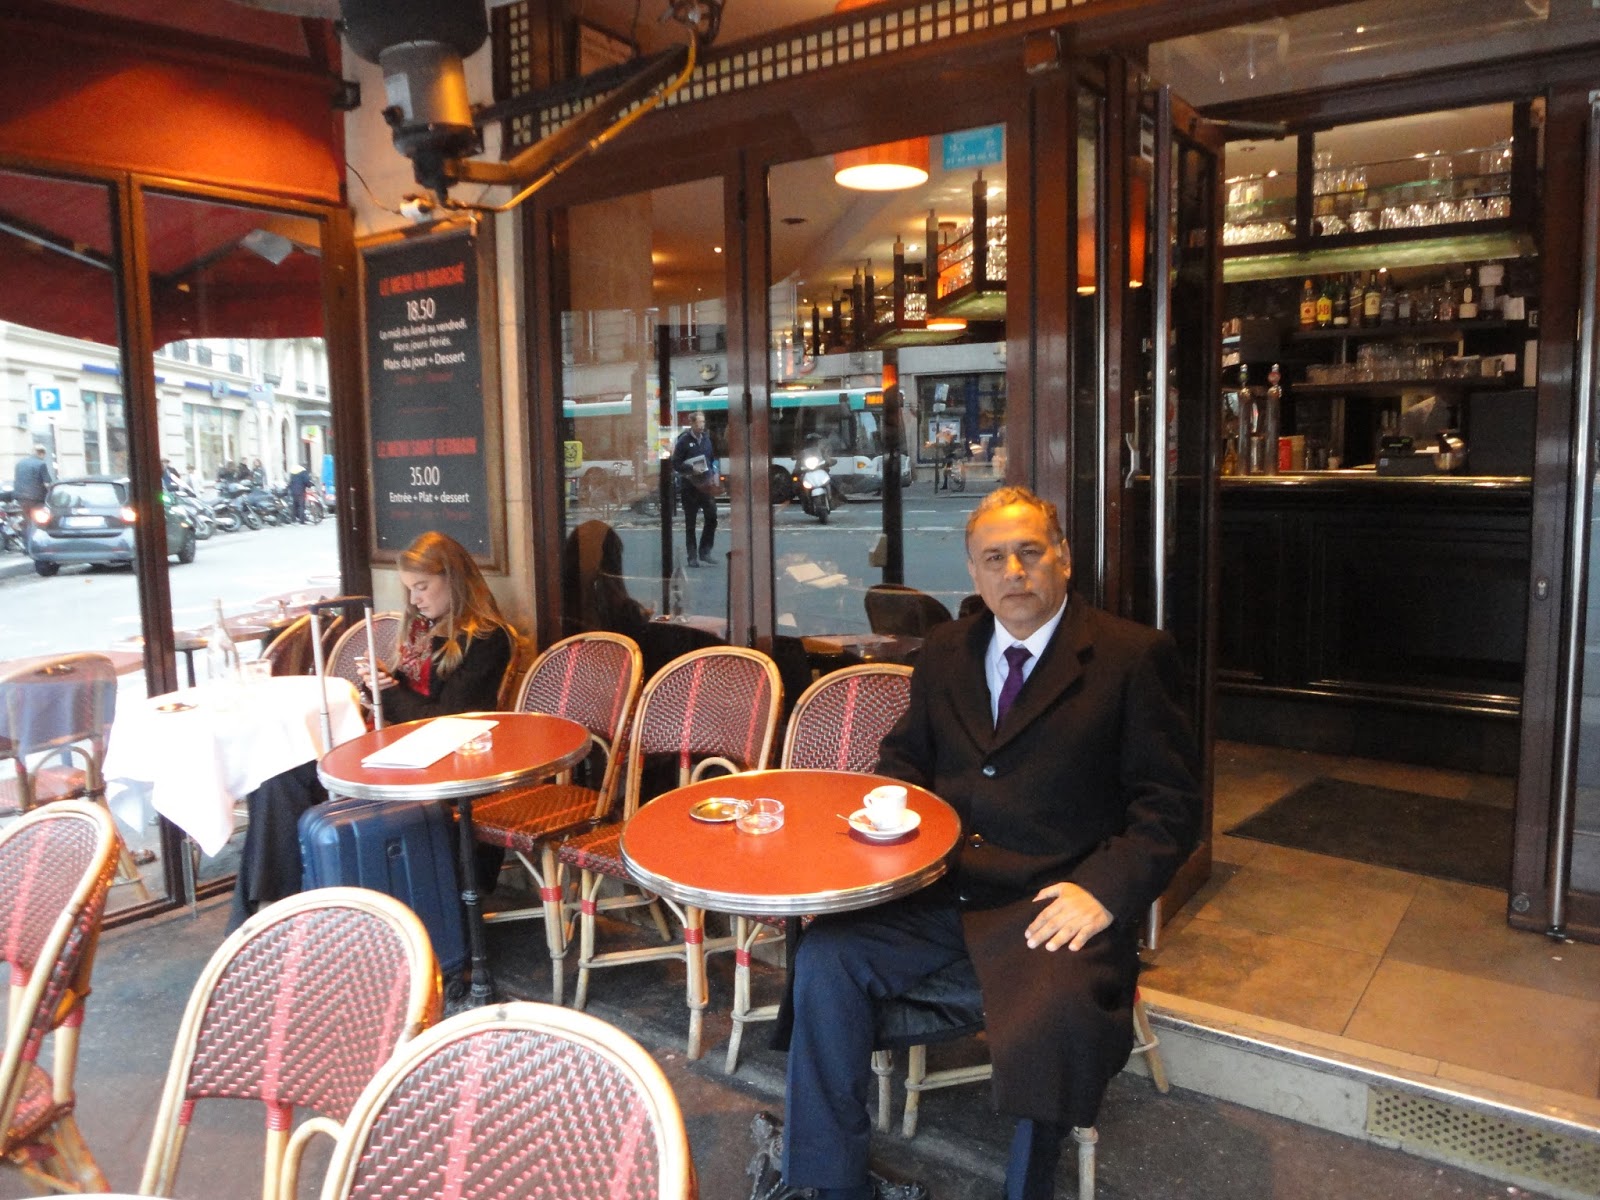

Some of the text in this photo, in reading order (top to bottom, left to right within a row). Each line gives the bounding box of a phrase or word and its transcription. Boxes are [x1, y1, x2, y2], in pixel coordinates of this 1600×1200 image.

[406, 297, 437, 321] 18.50
[427, 323, 436, 333] au
[393, 342, 409, 352] Hors
[410, 339, 429, 352] jours
[401, 355, 412, 369] du
[411, 355, 428, 371] jour
[434, 351, 466, 366] Dessert
[40, 390, 56, 409] P
[409, 465, 440, 486] 35.00
[389, 491, 412, 503] Entrée
[418, 490, 433, 503] Plat
[440, 490, 470, 503] dessert
